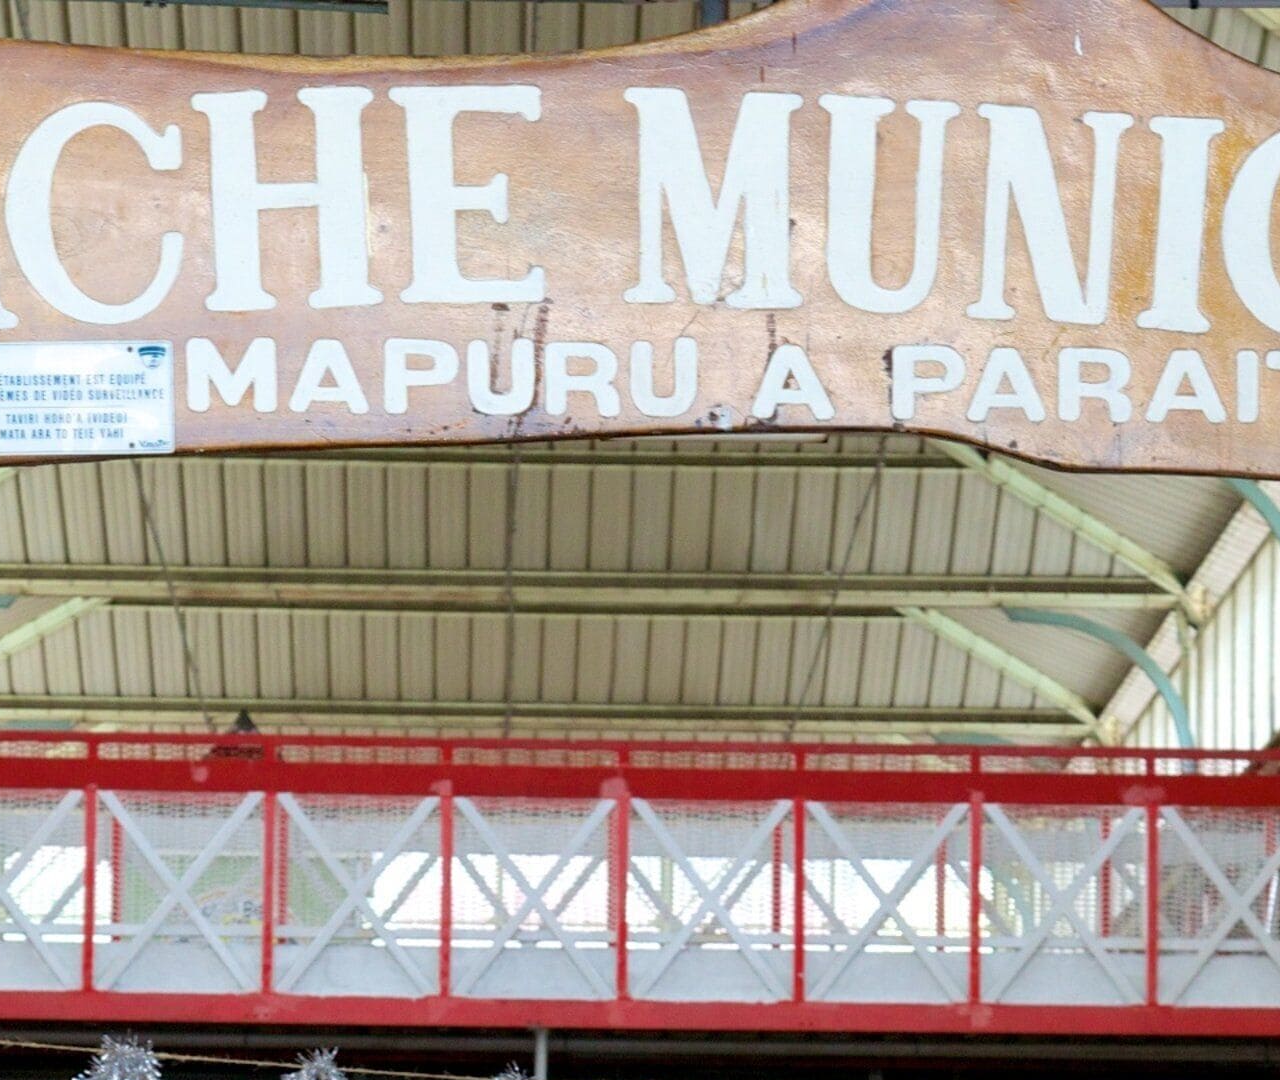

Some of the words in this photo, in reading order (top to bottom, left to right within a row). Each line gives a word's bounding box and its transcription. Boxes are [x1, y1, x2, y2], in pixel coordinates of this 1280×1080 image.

[86, 373, 105, 385] EST
[186, 336, 697, 418] MAPURU
[756, 344, 834, 420] A
[34, 389, 48, 401] DE
[88, 388, 165, 401] SURVEILLANCE
[0, 428, 26, 440] MATA
